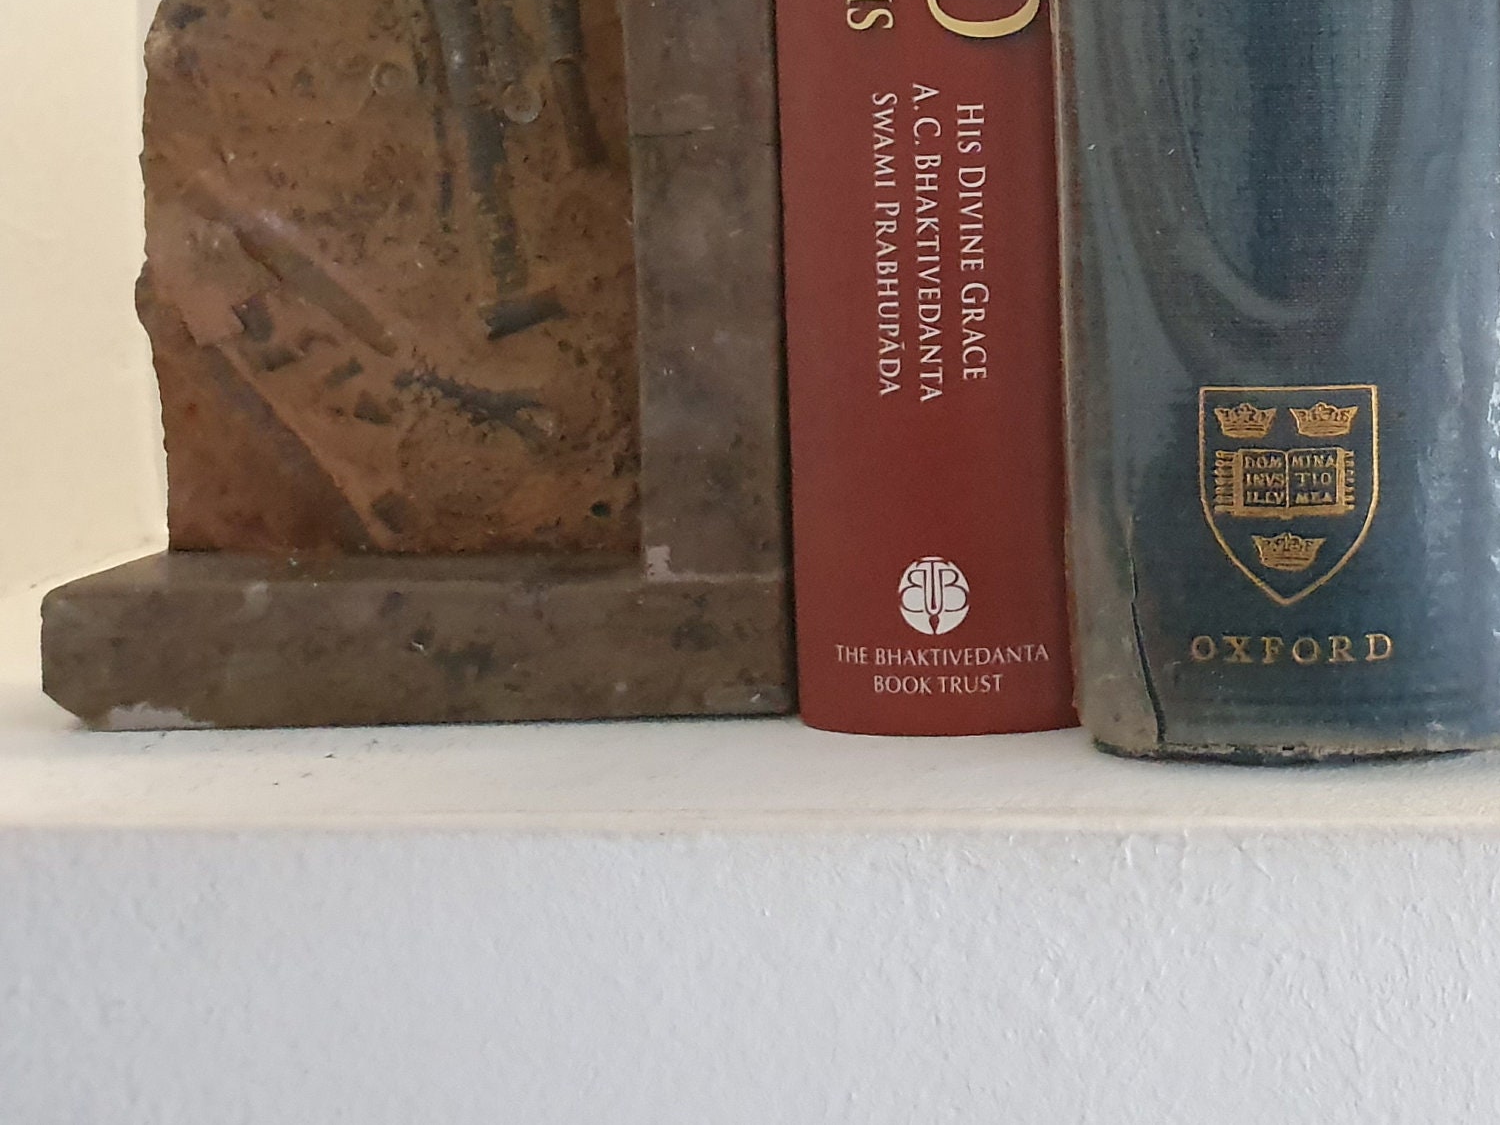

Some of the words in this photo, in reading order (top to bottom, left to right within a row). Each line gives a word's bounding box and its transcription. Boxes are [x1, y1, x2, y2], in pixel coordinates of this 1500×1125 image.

[914, 154, 943, 403] BHAKTIVEDANTA
[1292, 455, 1337, 468] MINA
[1295, 472, 1332, 485] TIO
[835, 644, 868, 665] THE
[874, 643, 1050, 666] BHAKTIVEDANTA
[1191, 633, 1394, 664] OXFORD
[874, 675, 932, 694] BOOK
[936, 674, 1003, 694] TRUST
